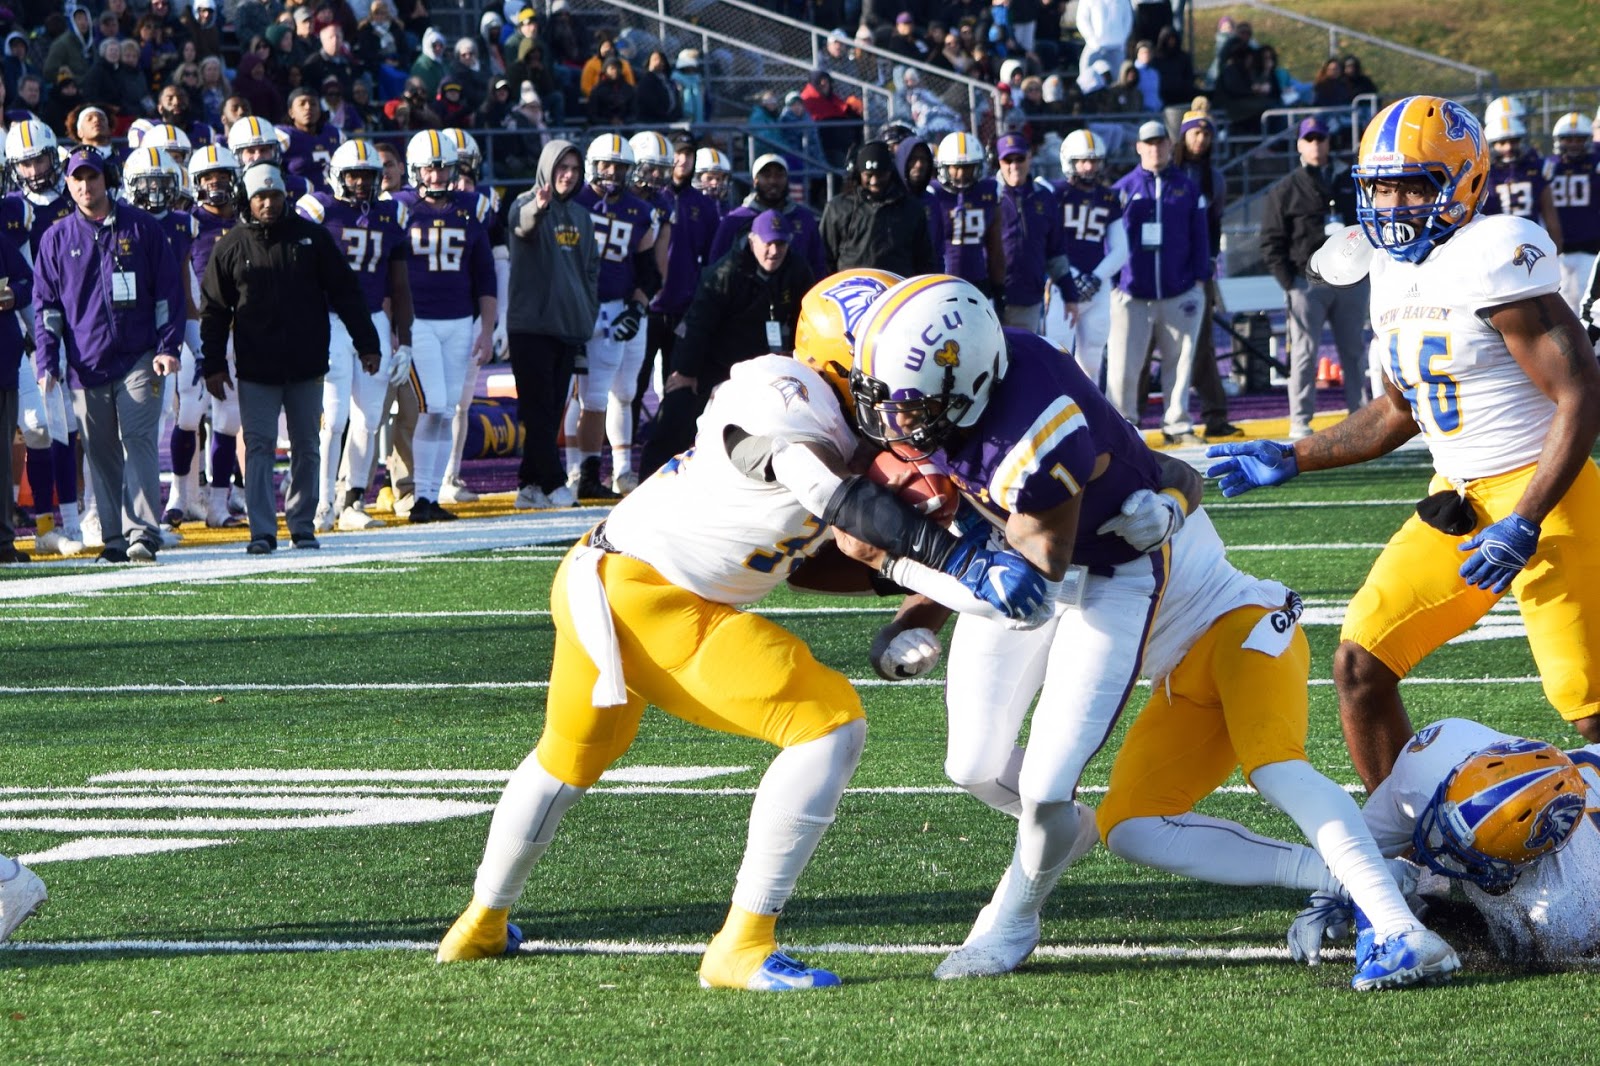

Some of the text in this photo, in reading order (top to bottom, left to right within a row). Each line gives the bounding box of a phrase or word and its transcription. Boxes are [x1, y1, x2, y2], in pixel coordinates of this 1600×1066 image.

[1495, 181, 1532, 217] 13
[949, 207, 986, 245] 19
[1064, 204, 1109, 243] 45
[342, 228, 383, 273] 31
[411, 227, 466, 272] 46
[1402, 305, 1452, 321] HAVEN
[904, 310, 963, 372] WCU
[1049, 462, 1082, 497] 1
